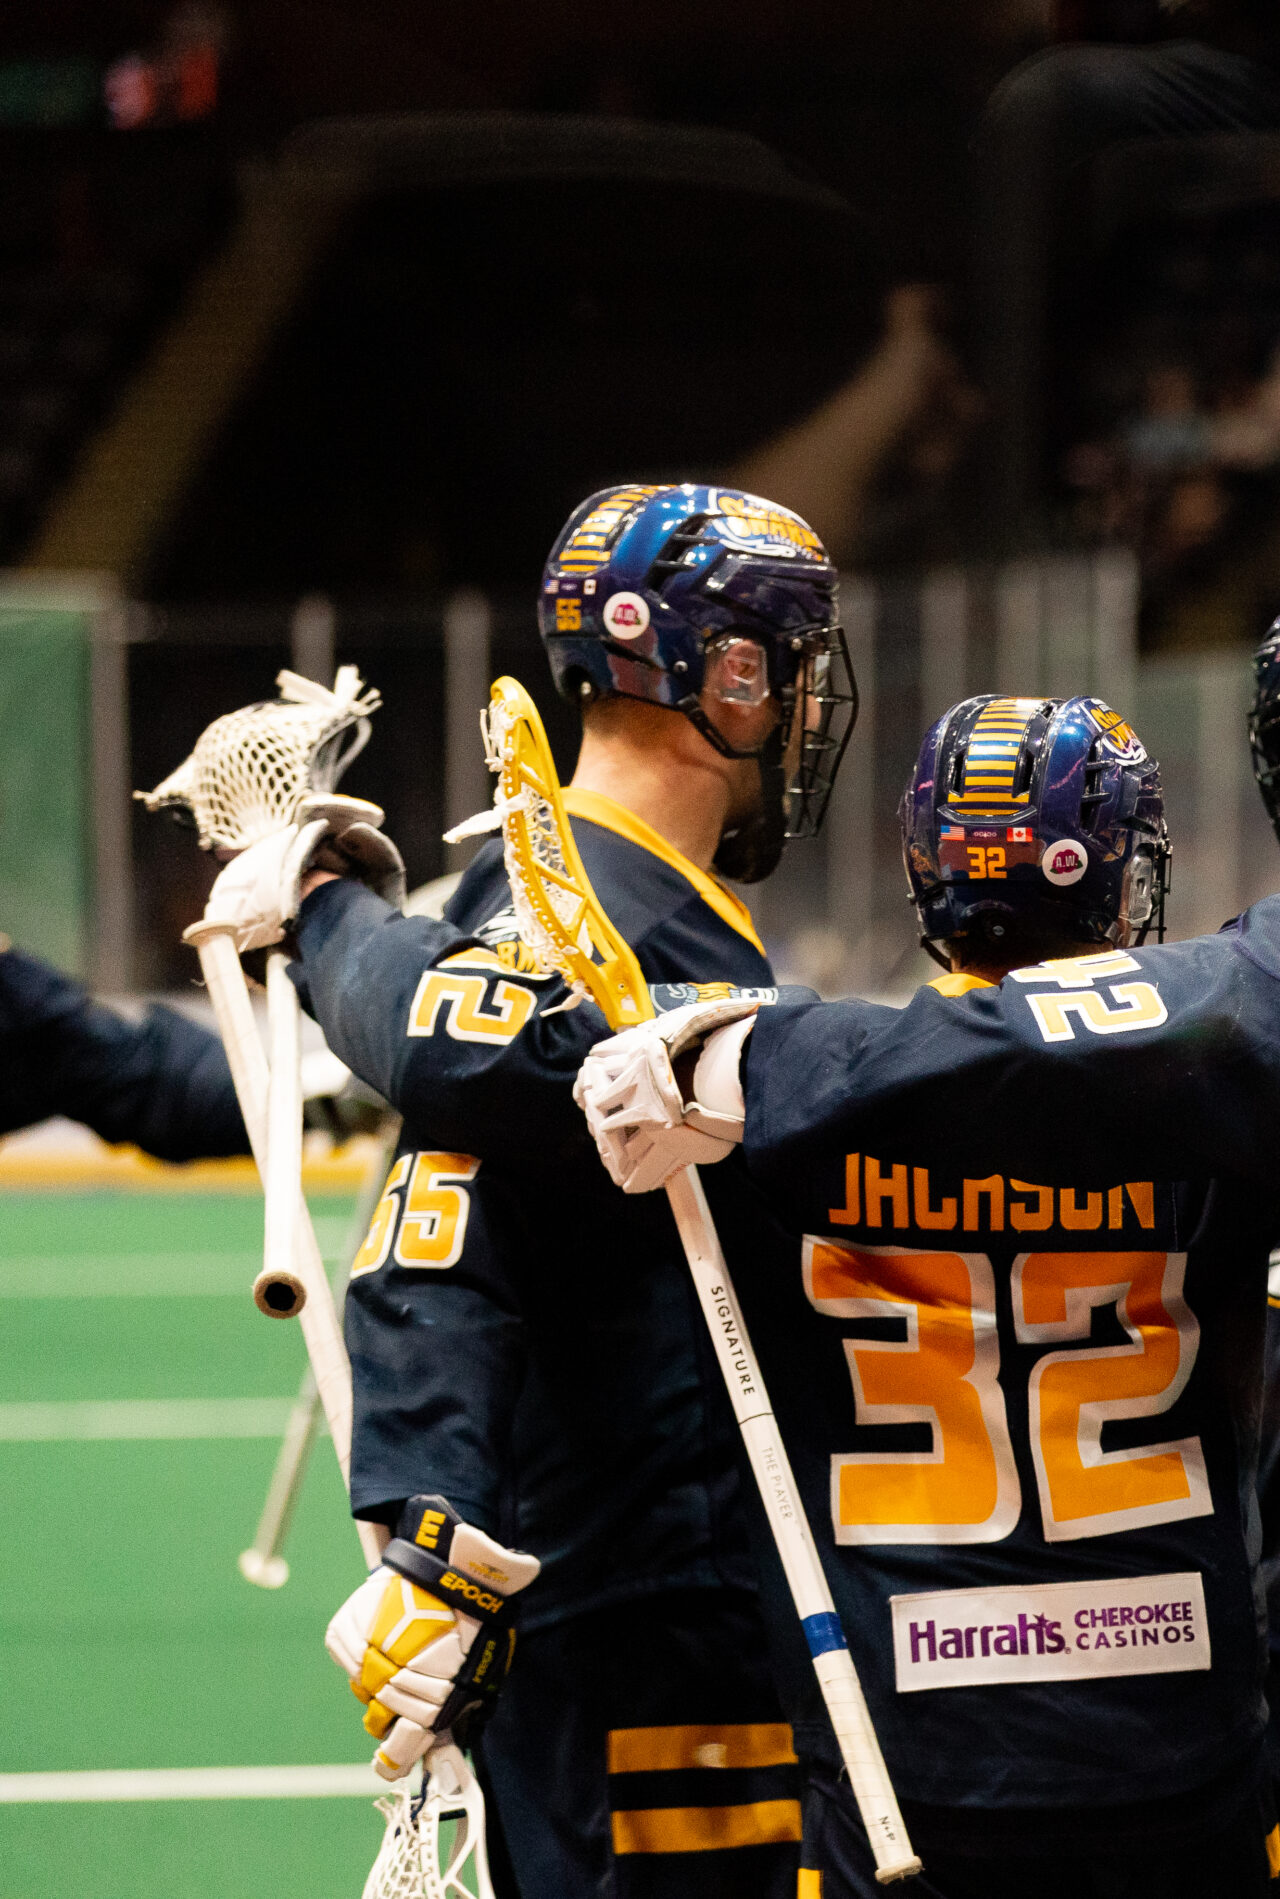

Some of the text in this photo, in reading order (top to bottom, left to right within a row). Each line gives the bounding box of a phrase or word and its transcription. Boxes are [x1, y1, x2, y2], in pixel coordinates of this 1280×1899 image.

[966, 846, 1008, 879] 32
[1055, 855, 1078, 868] A.W.
[1008, 949, 1168, 1042] 42
[710, 1285, 755, 1396] SIGNATURE
[802, 1233, 1214, 1546] 32
[760, 1447, 793, 1521] THE PLAYER
[439, 1570, 504, 1614] EPOCH
[1074, 1601, 1193, 1629] CHEROKEE
[909, 1613, 1066, 1663] Harrah's
[1075, 1625, 1195, 1651] CASINOS
